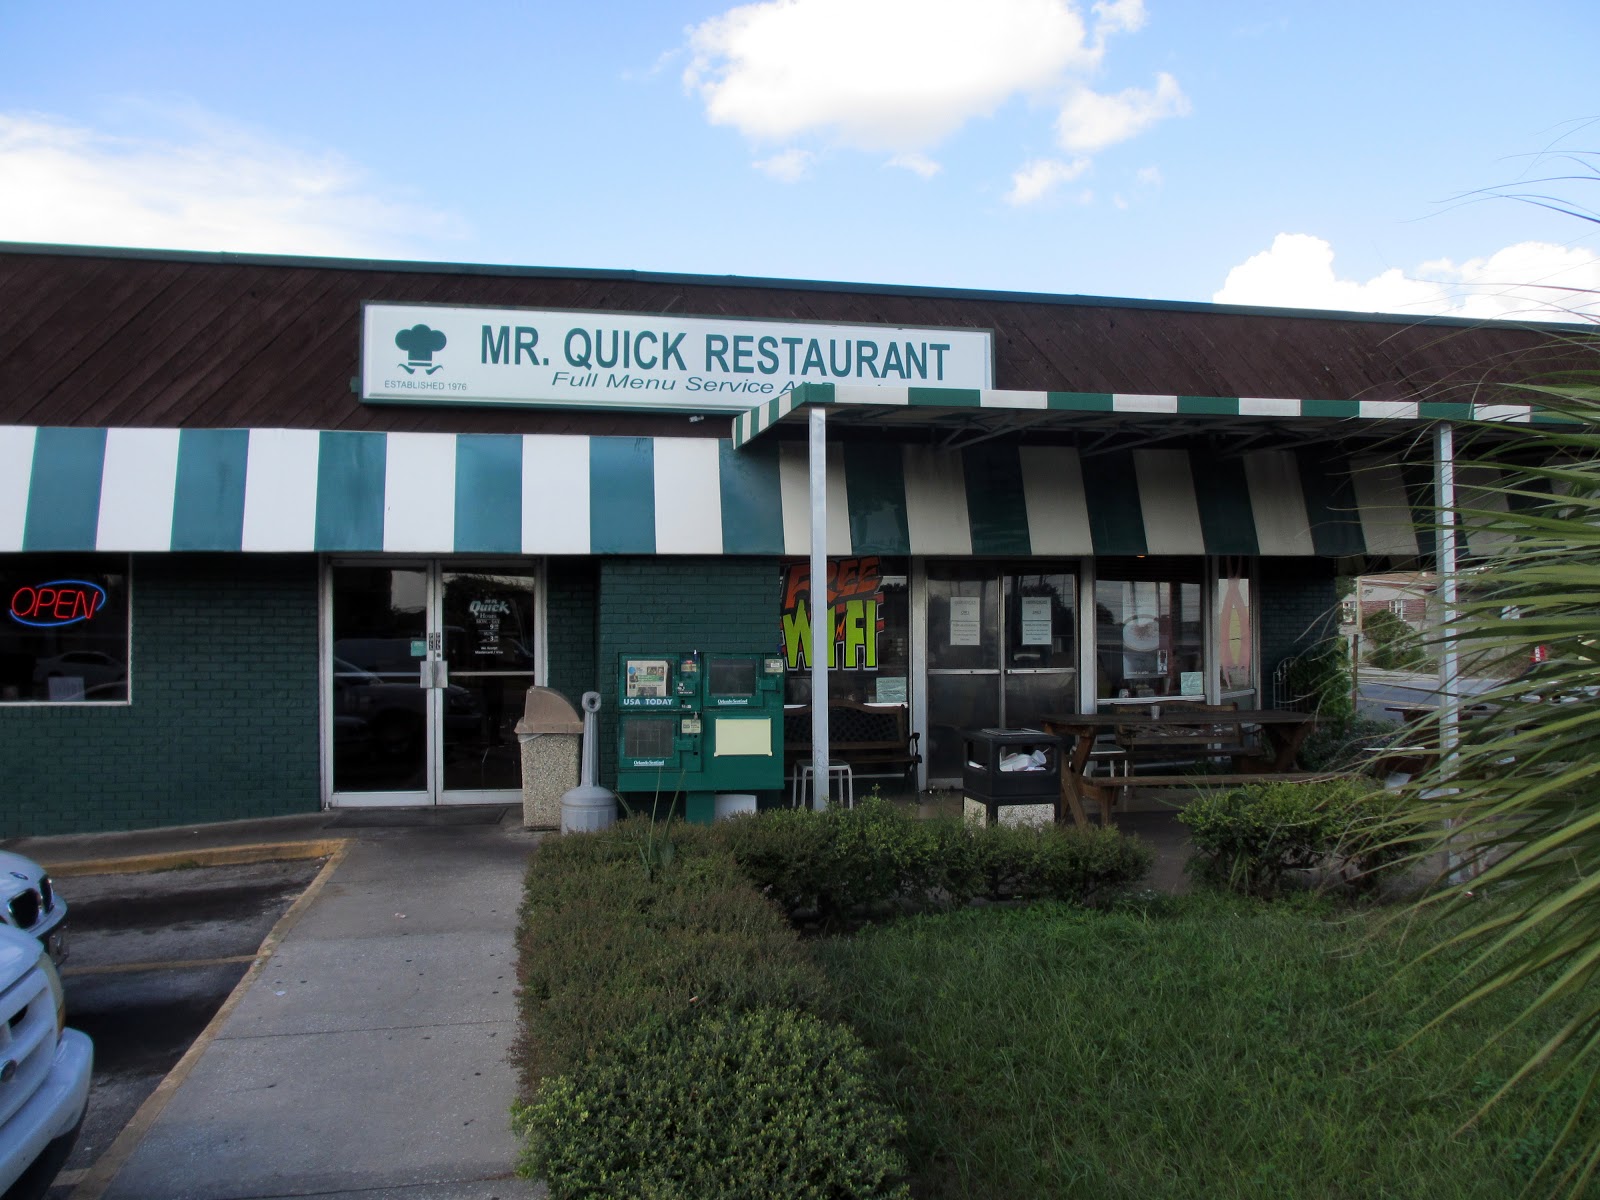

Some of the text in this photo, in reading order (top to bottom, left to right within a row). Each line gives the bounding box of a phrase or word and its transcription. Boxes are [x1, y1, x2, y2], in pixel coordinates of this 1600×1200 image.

[481, 325, 951, 381] MR. QUICK RESTAURANT
[384, 379, 468, 391] ESTABLISHED 1976
[552, 371, 599, 388] Full
[606, 373, 676, 391] Menu
[685, 376, 774, 394] Service
[11, 587, 99, 619] OPEN
[469, 600, 510, 616] Quick
[623, 698, 673, 706] USA TODAY
